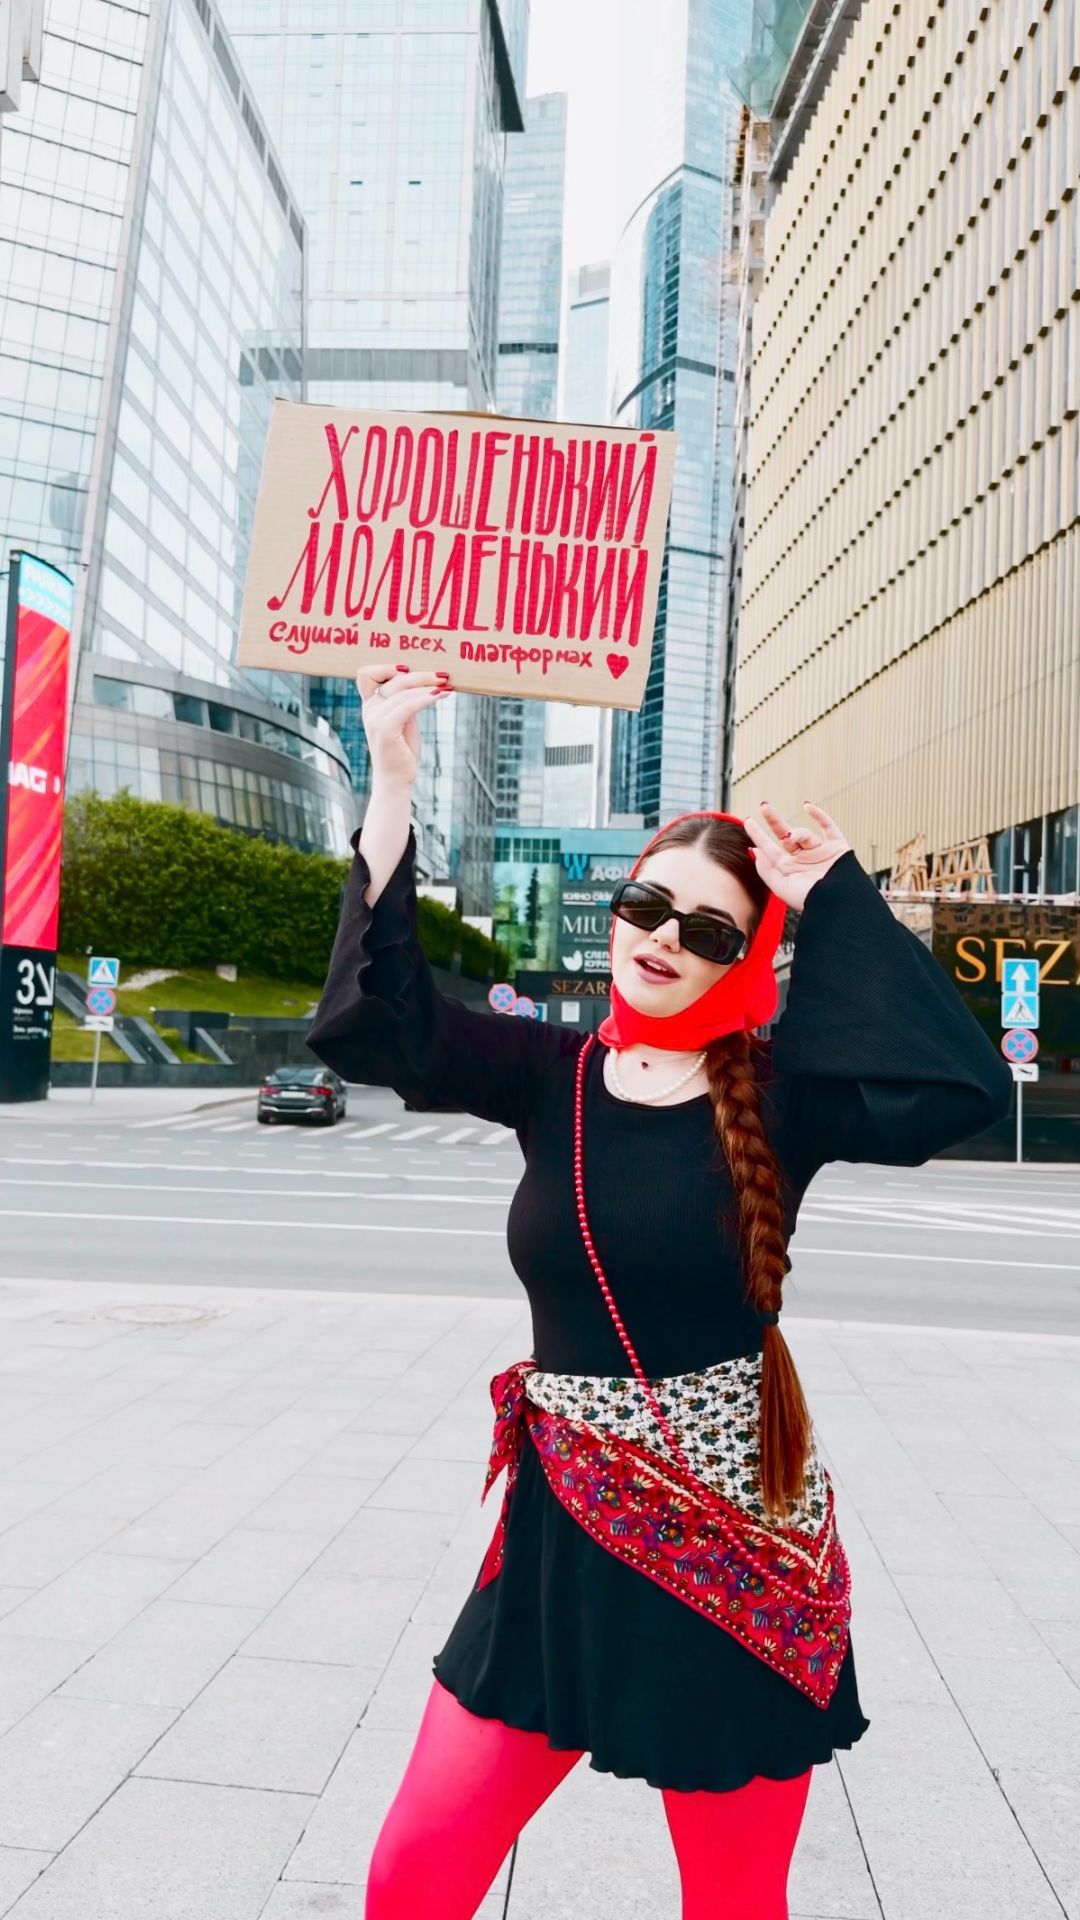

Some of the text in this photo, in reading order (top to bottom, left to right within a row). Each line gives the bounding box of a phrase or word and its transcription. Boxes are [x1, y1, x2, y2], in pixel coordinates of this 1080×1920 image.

[307, 423, 658, 544] ХОРОШЕНЬКИЙ
[266, 521, 649, 647] МОЛОДЕНЬКИЙ
[369, 631, 391, 648] на
[459, 640, 593, 675] платформах
[562, 915, 612, 935] MIU
[552, 980, 608, 995] SEZAR
